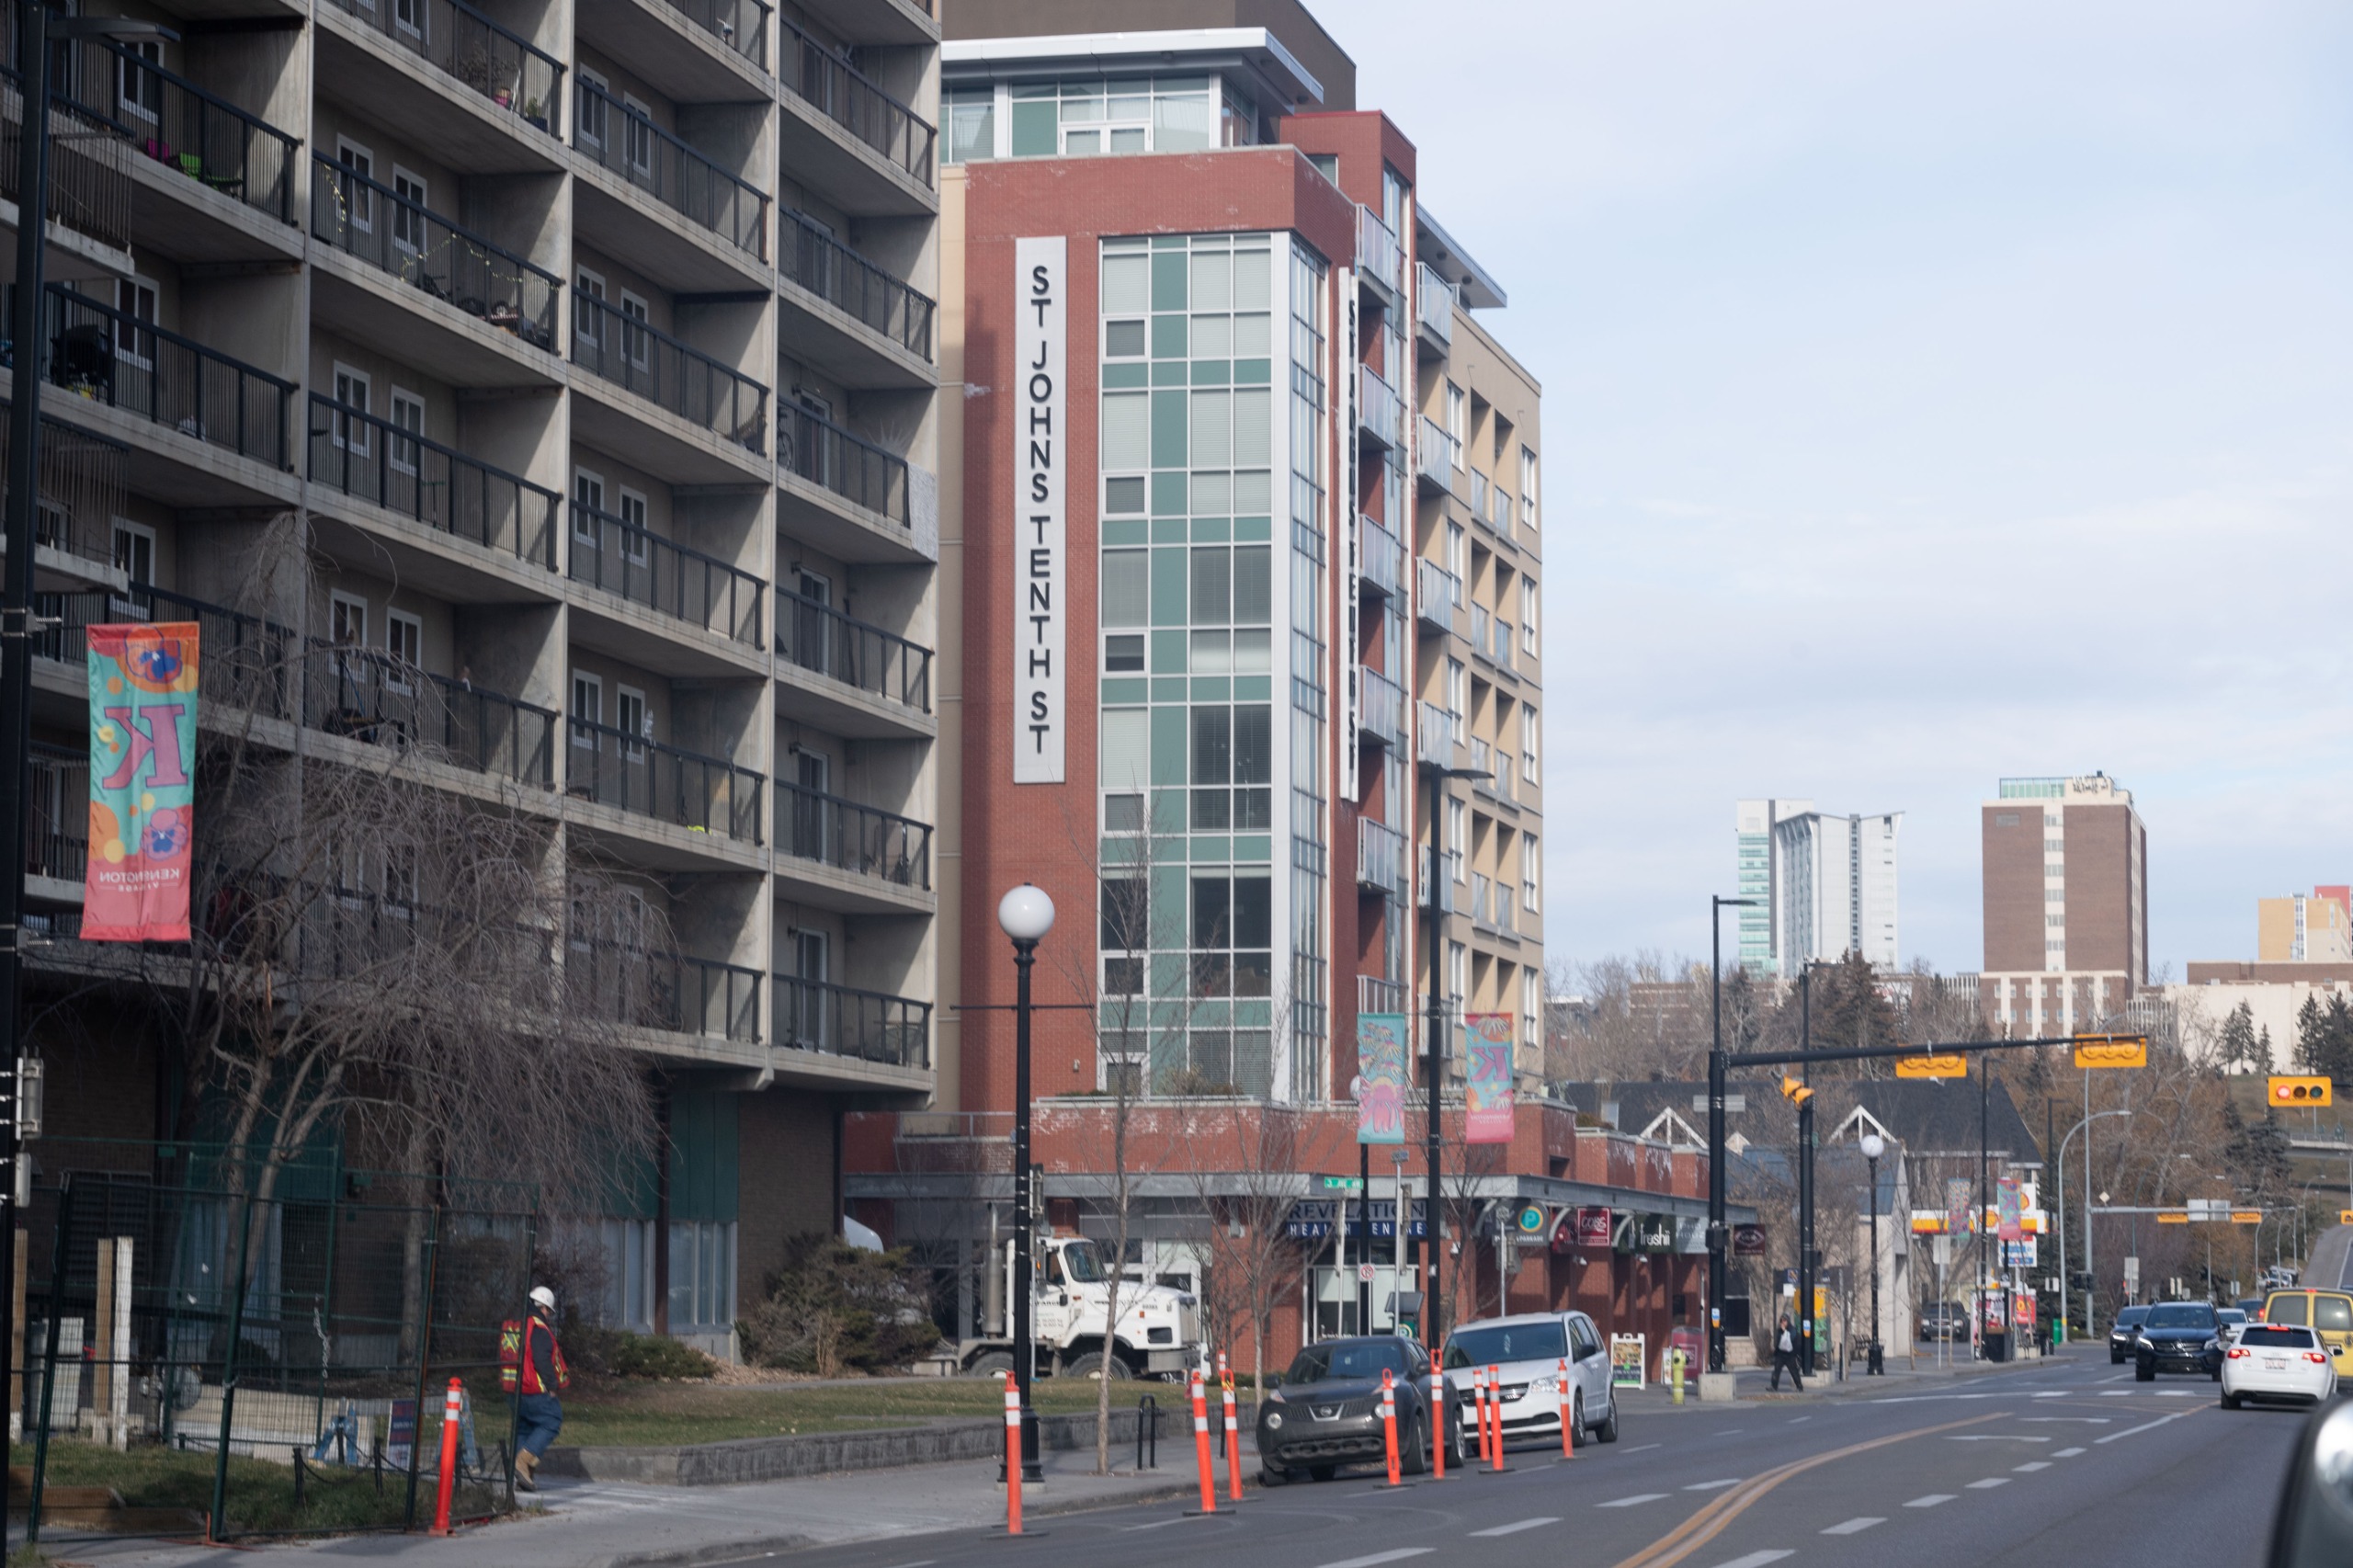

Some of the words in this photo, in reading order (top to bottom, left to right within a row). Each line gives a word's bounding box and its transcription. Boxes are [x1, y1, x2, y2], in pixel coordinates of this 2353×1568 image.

[1030, 266, 1051, 327] ST
[1029, 340, 1052, 503] JOHNS
[1029, 516, 1051, 678] TENTH
[1029, 690, 1050, 754] ST
[1289, 1201, 1425, 1220] REVLTIN
[1290, 1222, 1351, 1236] HEALH
[1581, 1216, 1607, 1231] COBS
[1641, 1222, 1671, 1246] freshii
